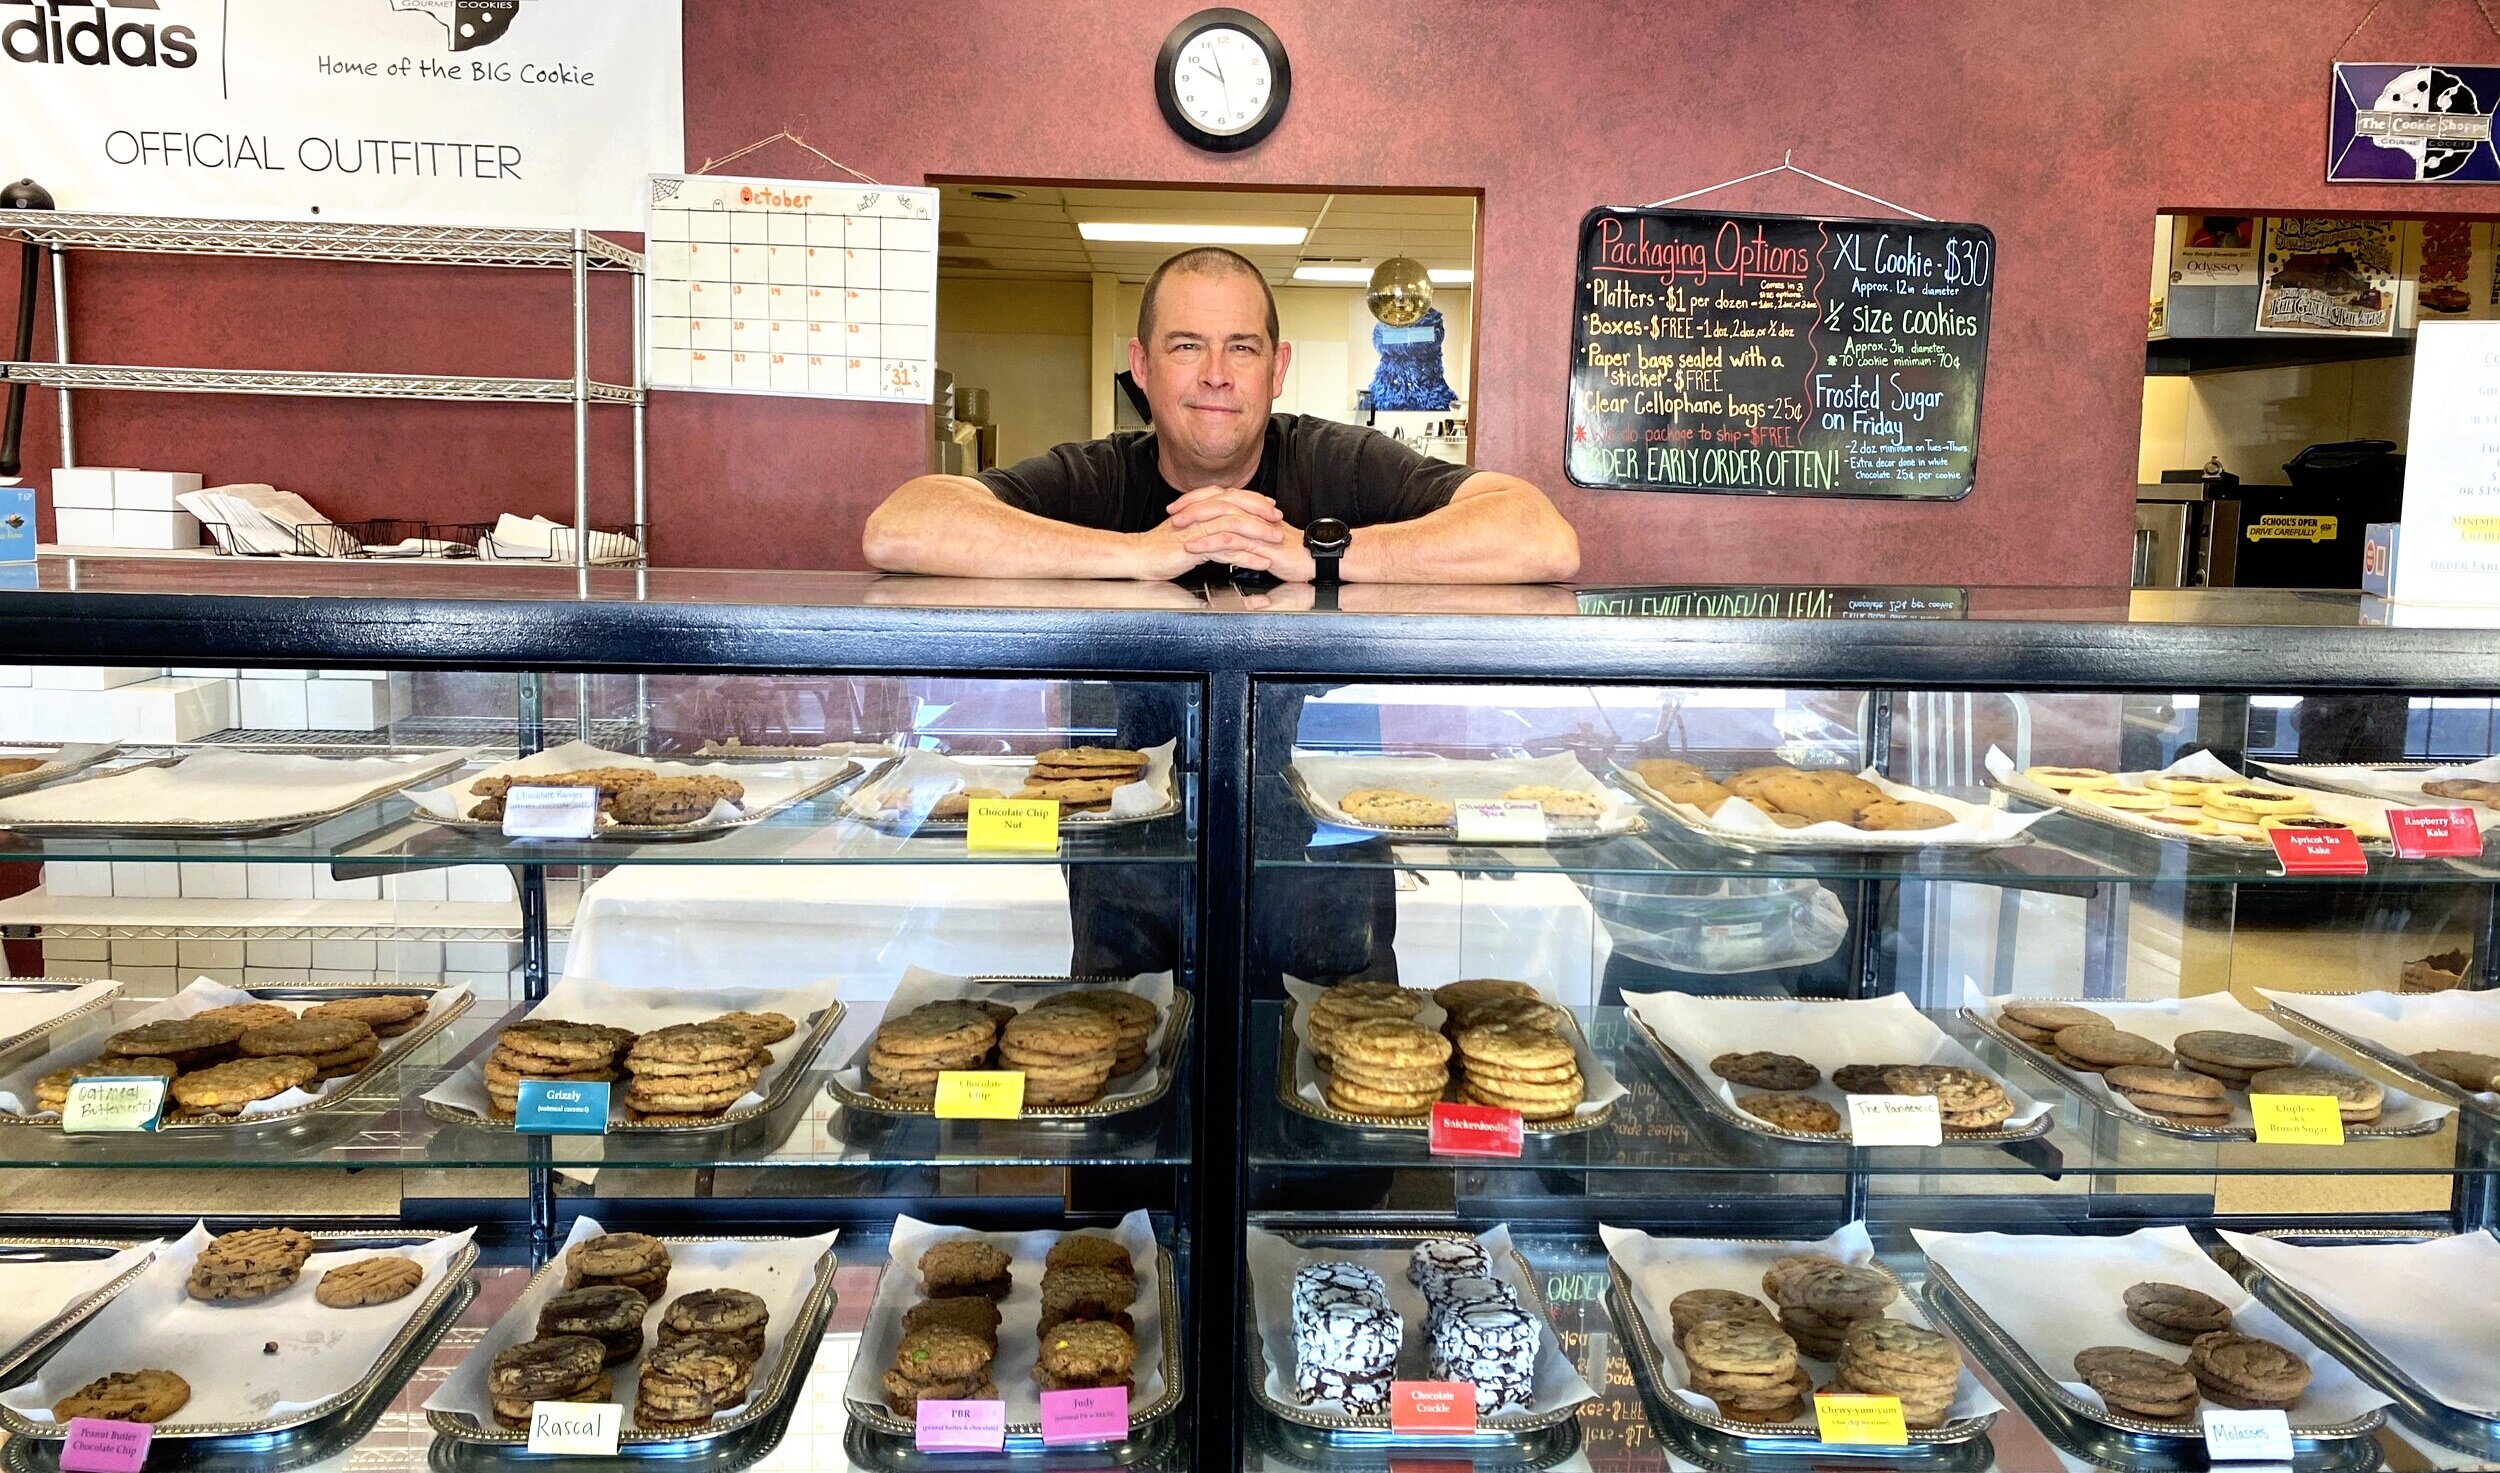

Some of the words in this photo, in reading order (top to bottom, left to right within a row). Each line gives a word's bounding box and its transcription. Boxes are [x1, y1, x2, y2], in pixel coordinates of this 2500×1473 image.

[458, 0, 513, 9] COOKIES
[1201, 41, 1212, 49] 11
[1217, 36, 1230, 44] 12
[318, 55, 378, 77] Home
[387, 57, 411, 77] of
[419, 58, 462, 80] the
[471, 61, 511, 82] BIG
[520, 63, 595, 86] Cookie
[1182, 74, 1190, 82] 9
[1256, 78, 1264, 86] 3
[1200, 110, 1208, 118] 7
[2360, 117, 2386, 130] The
[2392, 118, 2437, 132] Cookie
[2440, 119, 2488, 134] Shoppe
[2428, 140, 2471, 148] COOKIES
[105, 129, 285, 172] OFFICIAL
[298, 136, 523, 180] OUTFITTER
[740, 187, 813, 208] October
[770, 247, 777, 256] 7
[1597, 217, 1707, 286] Packaging
[1715, 221, 1809, 286] Options
[1833, 233, 1867, 272] XL
[2187, 261, 2245, 275] Odyssey
[692, 284, 703, 292] 12
[733, 286, 742, 295] 13
[1760, 280, 1785, 290] Comes
[1787, 282, 1795, 290] in
[1852, 276, 1893, 298] Approx.
[1922, 282, 1960, 296] diameter
[1594, 278, 1655, 309] Platters
[1690, 295, 1710, 315] per
[1715, 289, 1749, 309] dozen
[1903, 302, 1978, 337] cookies
[733, 322, 744, 331] 20
[772, 323, 780, 332] 21
[810, 324, 821, 332] 22
[848, 325, 860, 334] 23
[1778, 322, 1795, 338] doz
[1843, 336, 1887, 358] Approx.
[1911, 340, 1946, 354] diameter
[1588, 342, 1631, 378] Paper
[1638, 344, 1674, 378] bags
[1679, 346, 1723, 369] sealed
[1729, 347, 1767, 369] with
[1770, 355, 1785, 368] a
[1857, 355, 1889, 367] cookie
[693, 352, 706, 361] 26
[734, 353, 746, 363] 27
[772, 355, 785, 364] 28
[810, 357, 822, 366] 29
[849, 360, 861, 369] 30
[891, 368, 912, 386] 31
[1815, 373, 1880, 410] Frosted
[1890, 372, 1944, 421] Sugar
[1583, 391, 1629, 416] Clear
[1634, 391, 1723, 424] Cellophane
[1821, 412, 1844, 431] on
[1853, 409, 1904, 446] Friday
[1645, 425, 1694, 451] package
[1698, 424, 1712, 442] to
[1860, 440, 1877, 454] doz
[1880, 444, 1914, 454] minimum
[1898, 457, 1916, 467] done
[1918, 458, 1926, 466] in
[1929, 457, 1949, 466] white
[1702, 449, 1763, 486] ORDER
[1766, 449, 1840, 490] OFTEN!
[1919, 472, 1931, 483] per
[1935, 470, 1962, 480] cookie
[2261, 517, 2296, 527] SCHOOL'S
[2298, 518, 2318, 527] OPEN
[2250, 528, 2273, 536] DRIVE
[2274, 528, 2316, 536] CAREFULLY
[978, 807, 1024, 816] Chocolate
[1026, 808, 1049, 820] Chip
[1004, 820, 1022, 829] Nut
[2404, 816, 2448, 827] Raspberry
[2450, 815, 2466, 825] Tea
[2426, 828, 2449, 837] Kake
[2290, 835, 2323, 845] Apricot
[2325, 836, 2341, 844] Tea
[2307, 846, 2331, 855] Kake
[960, 1080, 1002, 1088] Chocolate
[78, 1085, 139, 1101] Oatmeal
[546, 1090, 581, 1103] Grizzly
[969, 1091, 991, 1100] Chip
[1855, 1101, 1880, 1115] The
[1884, 1101, 1935, 1114] Pandemic
[2276, 1104, 2315, 1114] Chipless
[1443, 1117, 1510, 1133] Snickerdoodle
[2270, 1123, 2300, 1133] Brown
[2302, 1124, 2328, 1135] Sugar
[1411, 1390, 1455, 1400] Chocolate
[1073, 1398, 1095, 1409] Judy
[1416, 1403, 1450, 1413] Crackle
[951, 1409, 971, 1418] PBR
[1821, 1405, 1897, 1416] Chewy-yum-yum
[536, 1413, 601, 1437] Rascal
[80, 1428, 109, 1440] Peanut
[110, 1431, 137, 1441] Butter
[2212, 1424, 2270, 1443] Molasses
[73, 1440, 115, 1453] Chocolate
[116, 1445, 137, 1458] Chip
